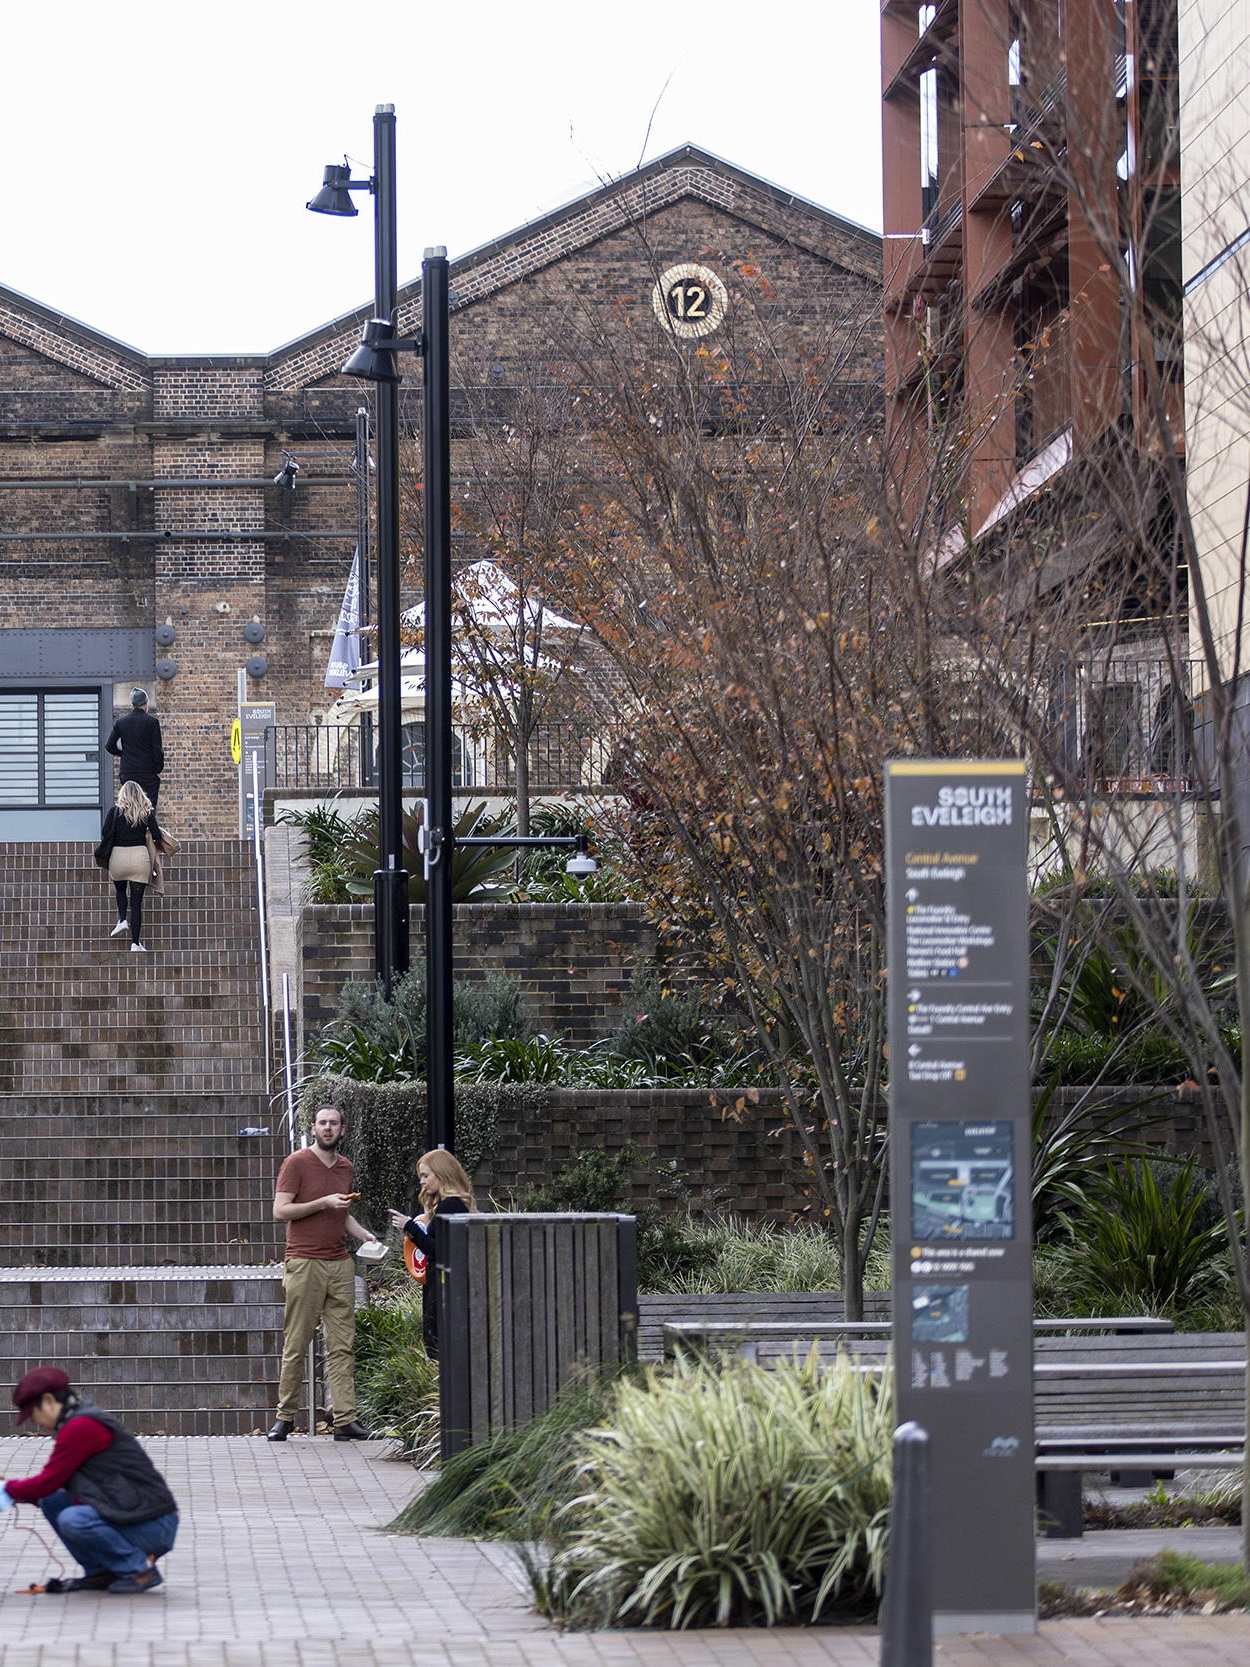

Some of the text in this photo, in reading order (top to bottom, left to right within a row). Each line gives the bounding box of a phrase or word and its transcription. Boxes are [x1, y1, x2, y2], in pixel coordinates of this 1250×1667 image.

[671, 286, 706, 317] 12
[938, 786, 1012, 807] SOUTH
[911, 806, 1012, 826] EVELEIGH
[905, 852, 978, 865] Central Avenue
[906, 867, 929, 879] South
